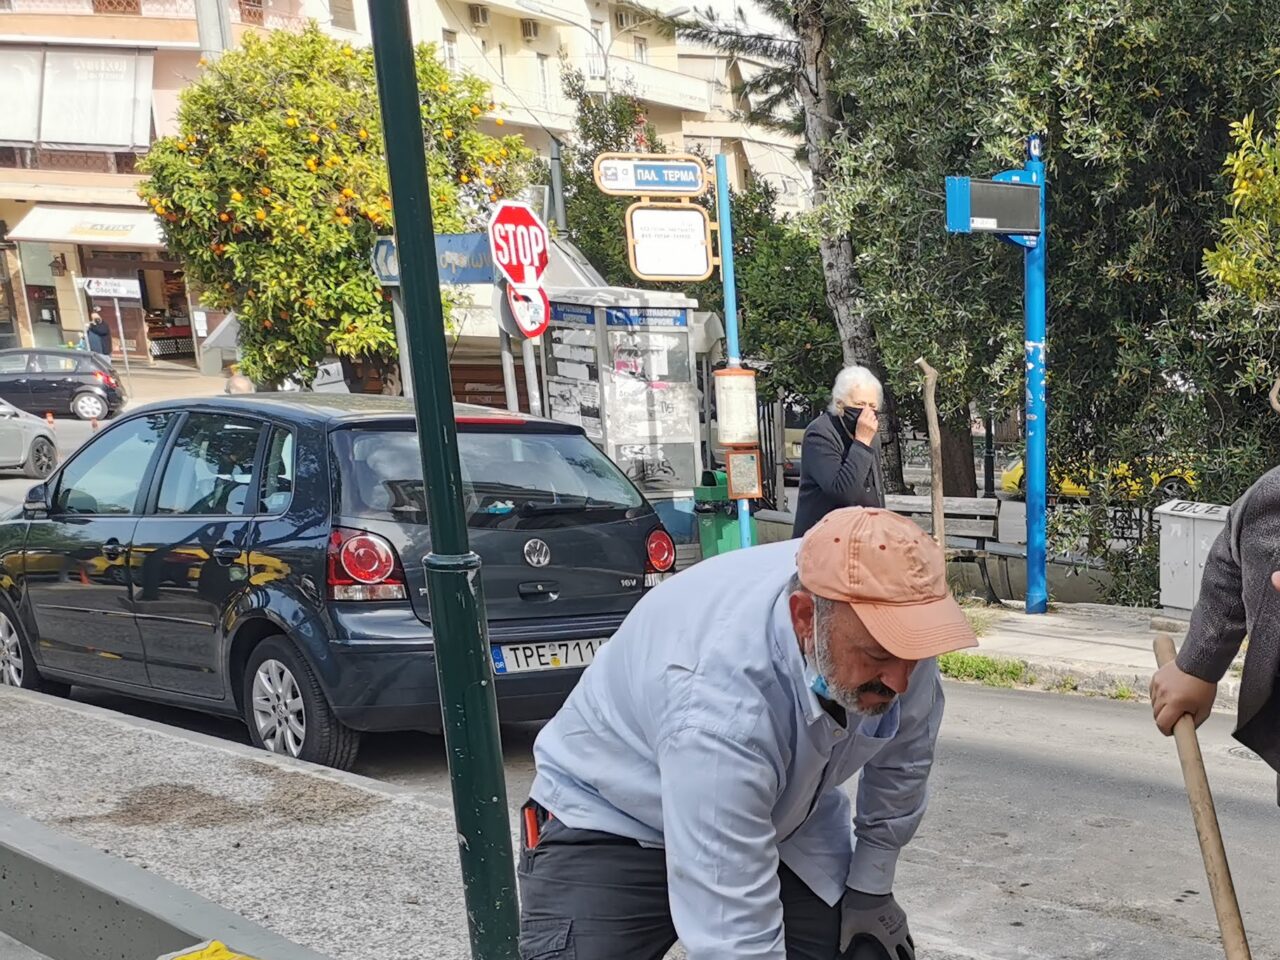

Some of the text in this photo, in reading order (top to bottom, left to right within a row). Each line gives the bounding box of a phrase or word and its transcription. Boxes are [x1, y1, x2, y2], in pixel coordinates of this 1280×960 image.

[662, 170, 695, 182] ΤΕΡΜΑ
[493, 223, 544, 267] STOP
[620, 579, 637, 588] 16V
